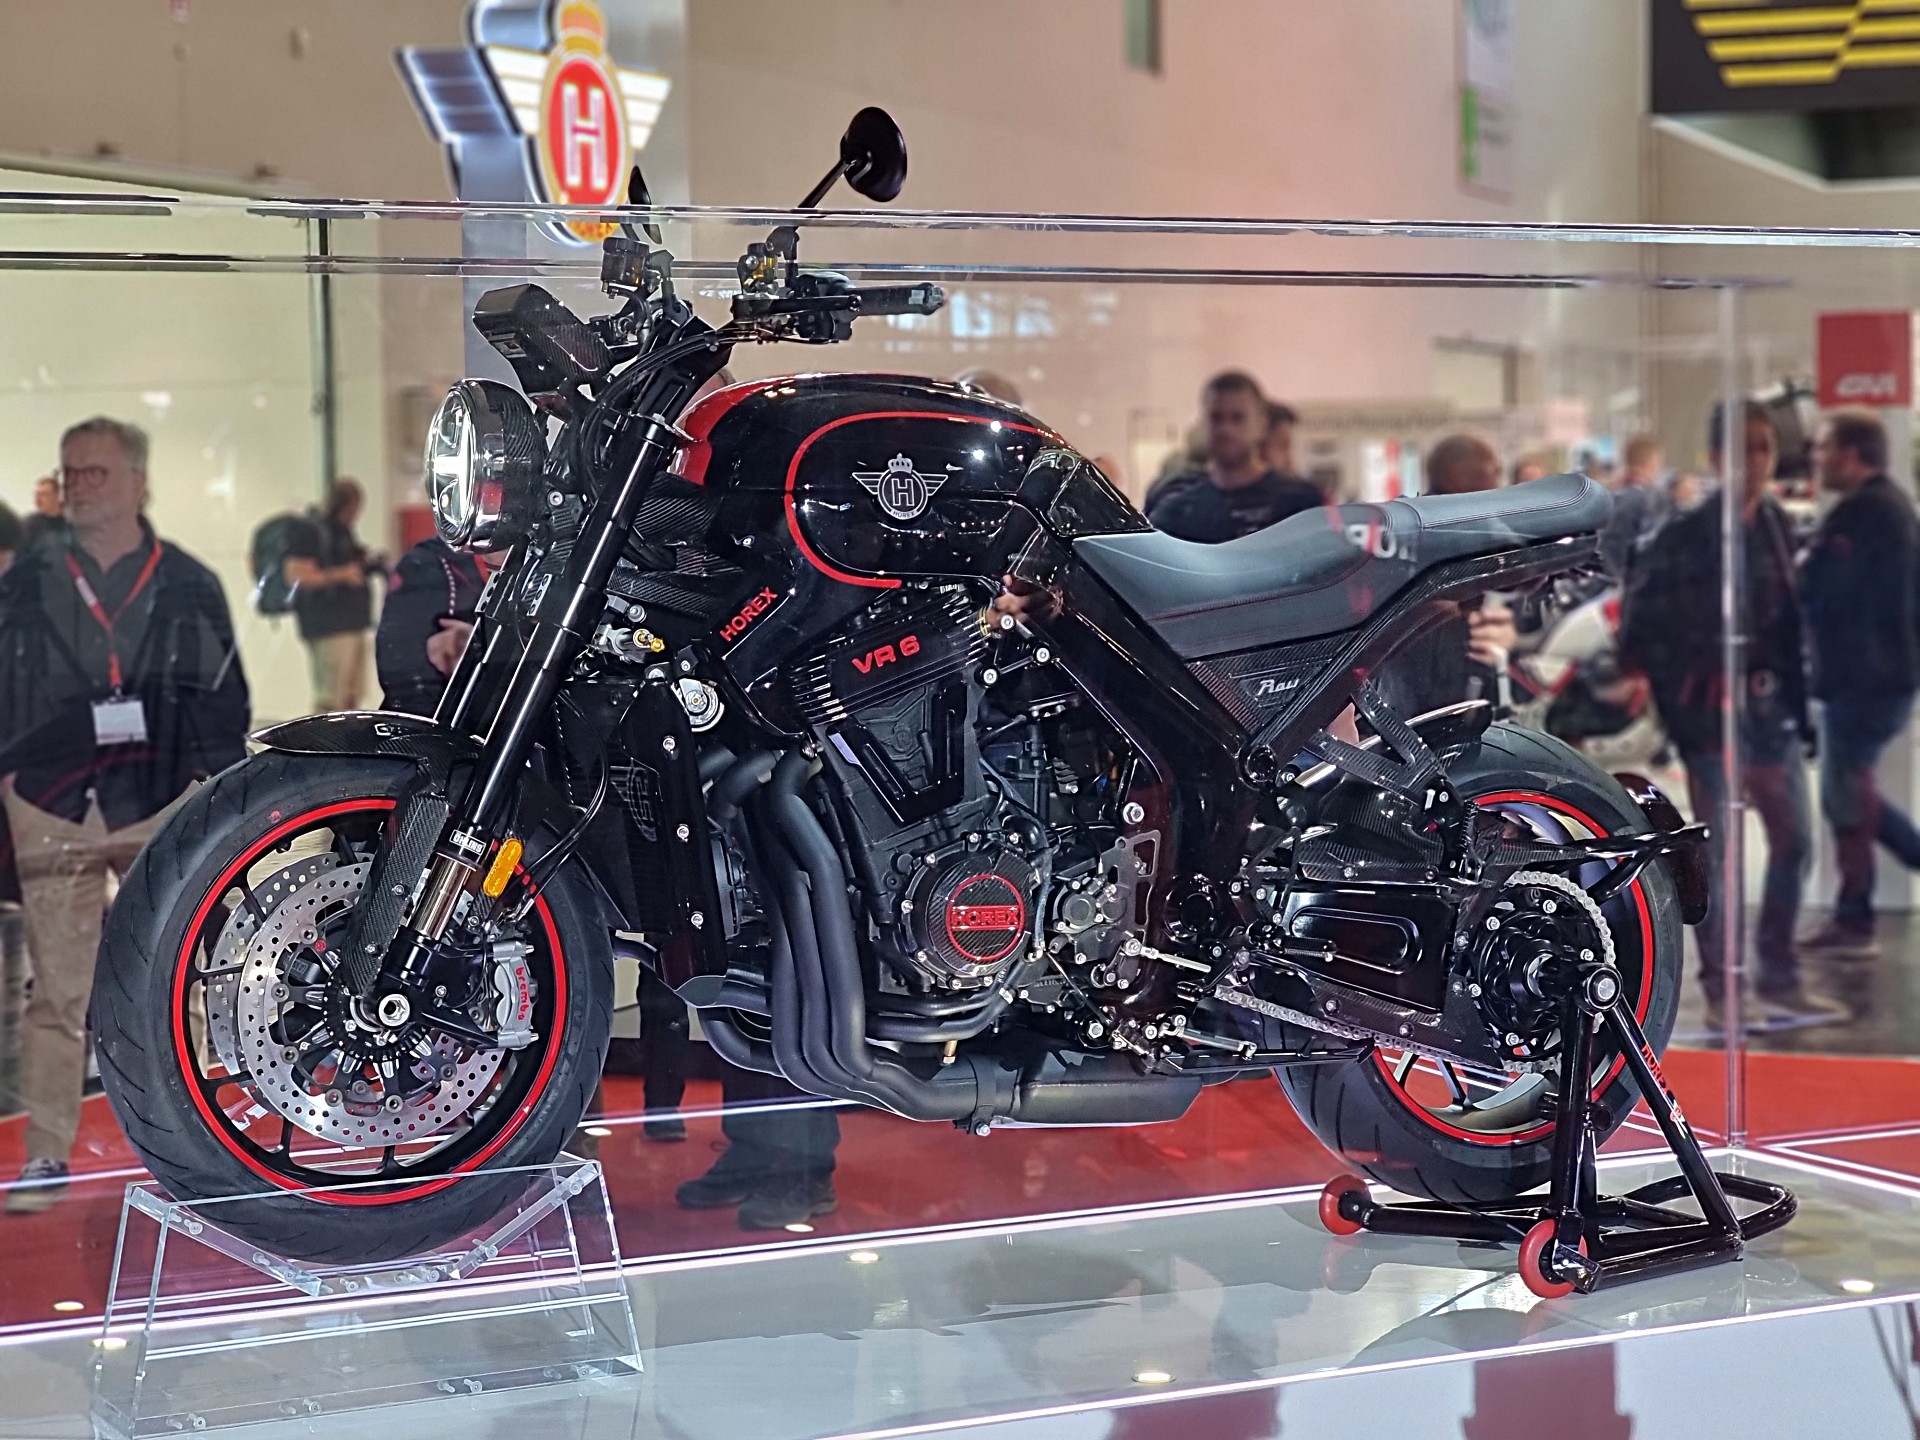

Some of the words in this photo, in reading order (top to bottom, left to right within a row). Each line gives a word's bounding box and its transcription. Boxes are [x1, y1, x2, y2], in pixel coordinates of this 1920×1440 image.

[562, 83, 608, 190] H
[719, 586, 778, 642] HOREX
[1257, 677, 1299, 696] Raw
[952, 910, 1018, 926] HOREX
[515, 966, 530, 1020] brembo
